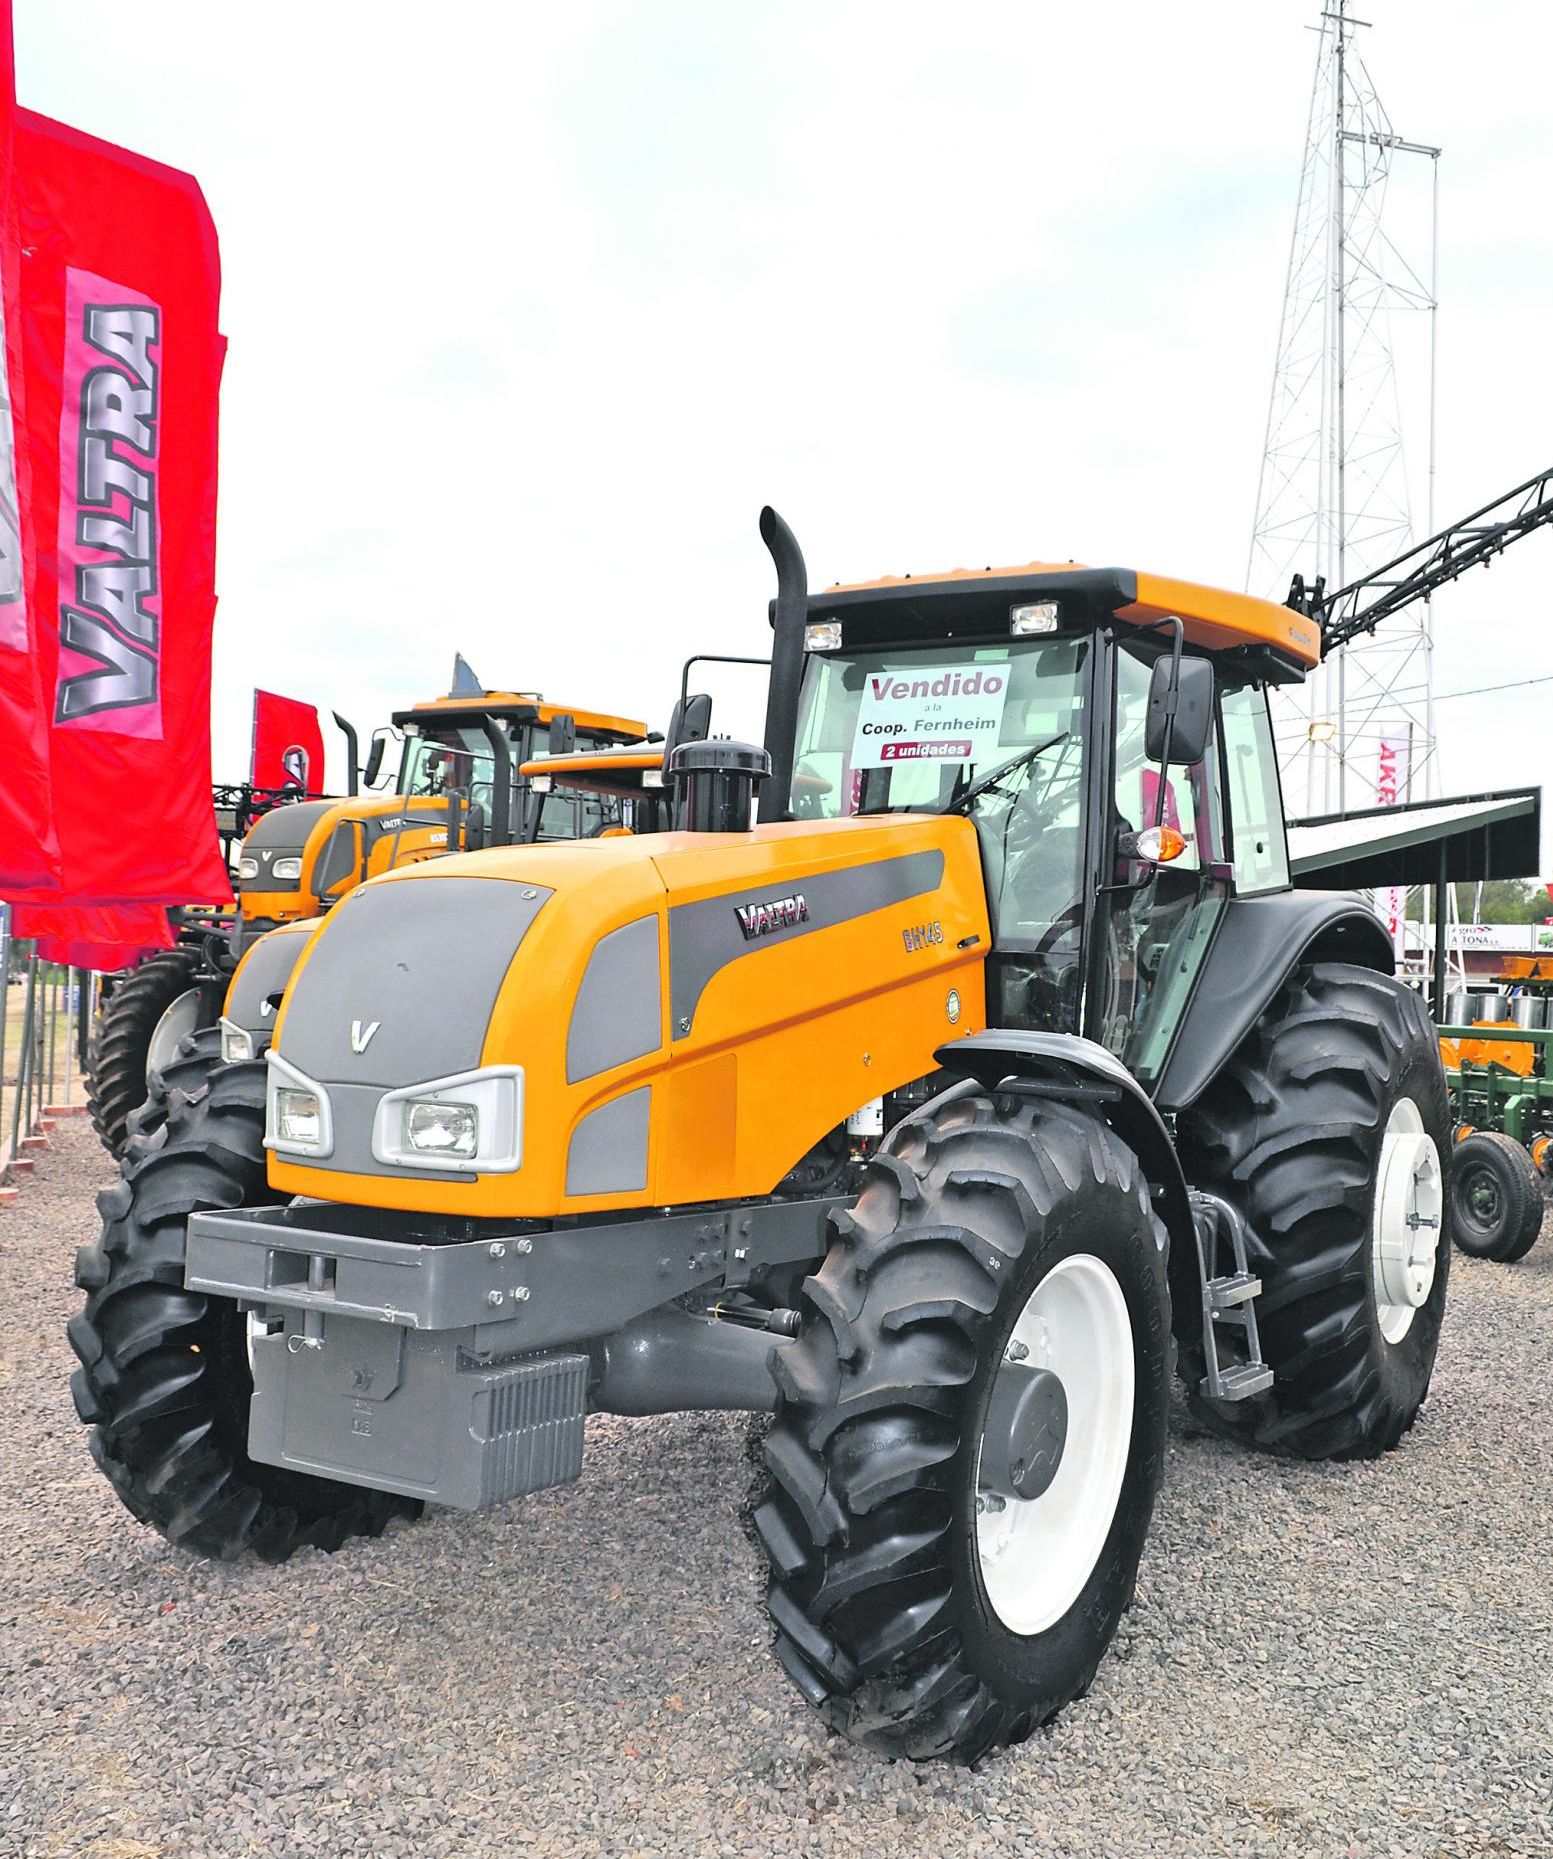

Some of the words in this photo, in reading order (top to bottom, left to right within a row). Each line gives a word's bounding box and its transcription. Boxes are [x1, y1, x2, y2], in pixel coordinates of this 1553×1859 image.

[55, 303, 160, 723] VALTRA
[871, 672, 1003, 701] Vendido
[924, 704, 930, 712] a
[933, 703, 942, 712] la
[862, 723, 907, 736] Coop.
[914, 717, 996, 732] Fernheim
[885, 746, 896, 758] 2
[899, 743, 966, 757] unidades
[734, 893, 809, 940] VALTRA
[1451, 936, 1489, 944] ATONA
